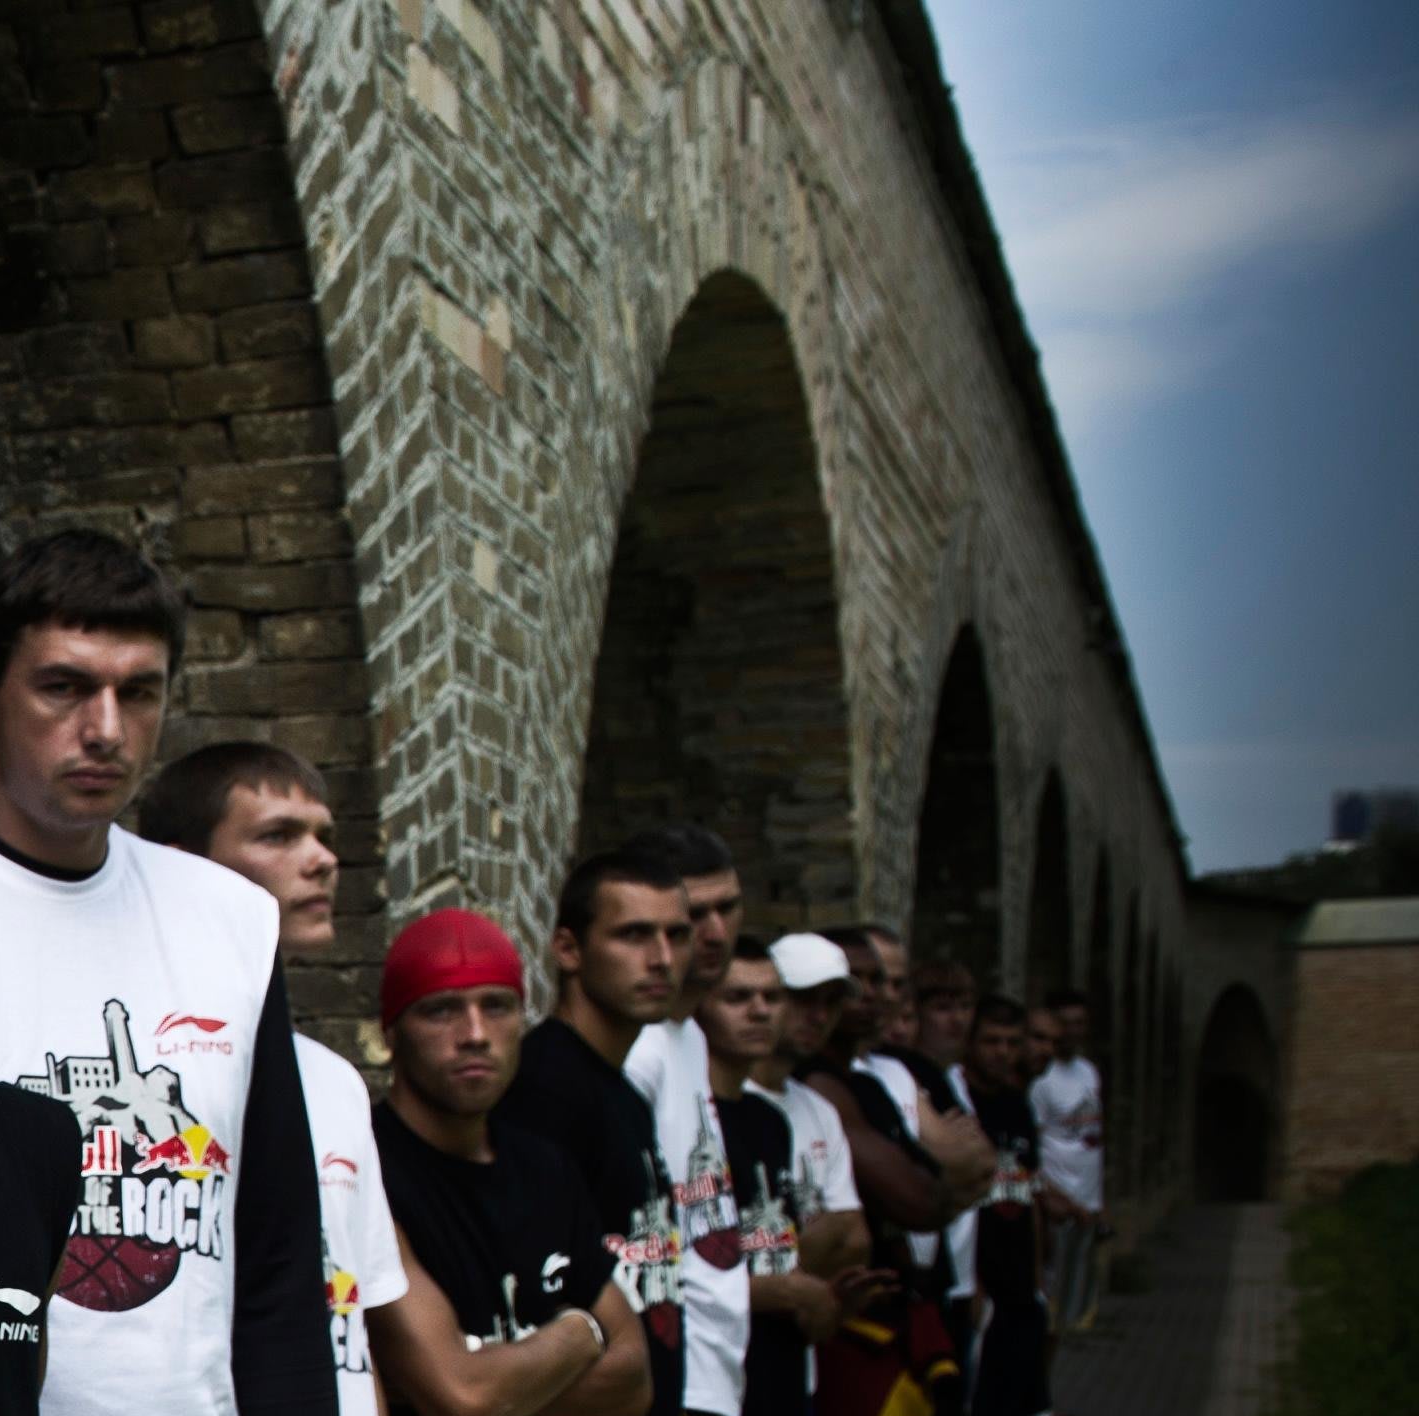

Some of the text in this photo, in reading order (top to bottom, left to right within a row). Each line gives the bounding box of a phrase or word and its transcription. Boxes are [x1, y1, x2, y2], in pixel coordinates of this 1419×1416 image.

[85, 1176, 113, 1206] OF
[78, 1206, 122, 1234] THE
[121, 1175, 224, 1260] ROCK
